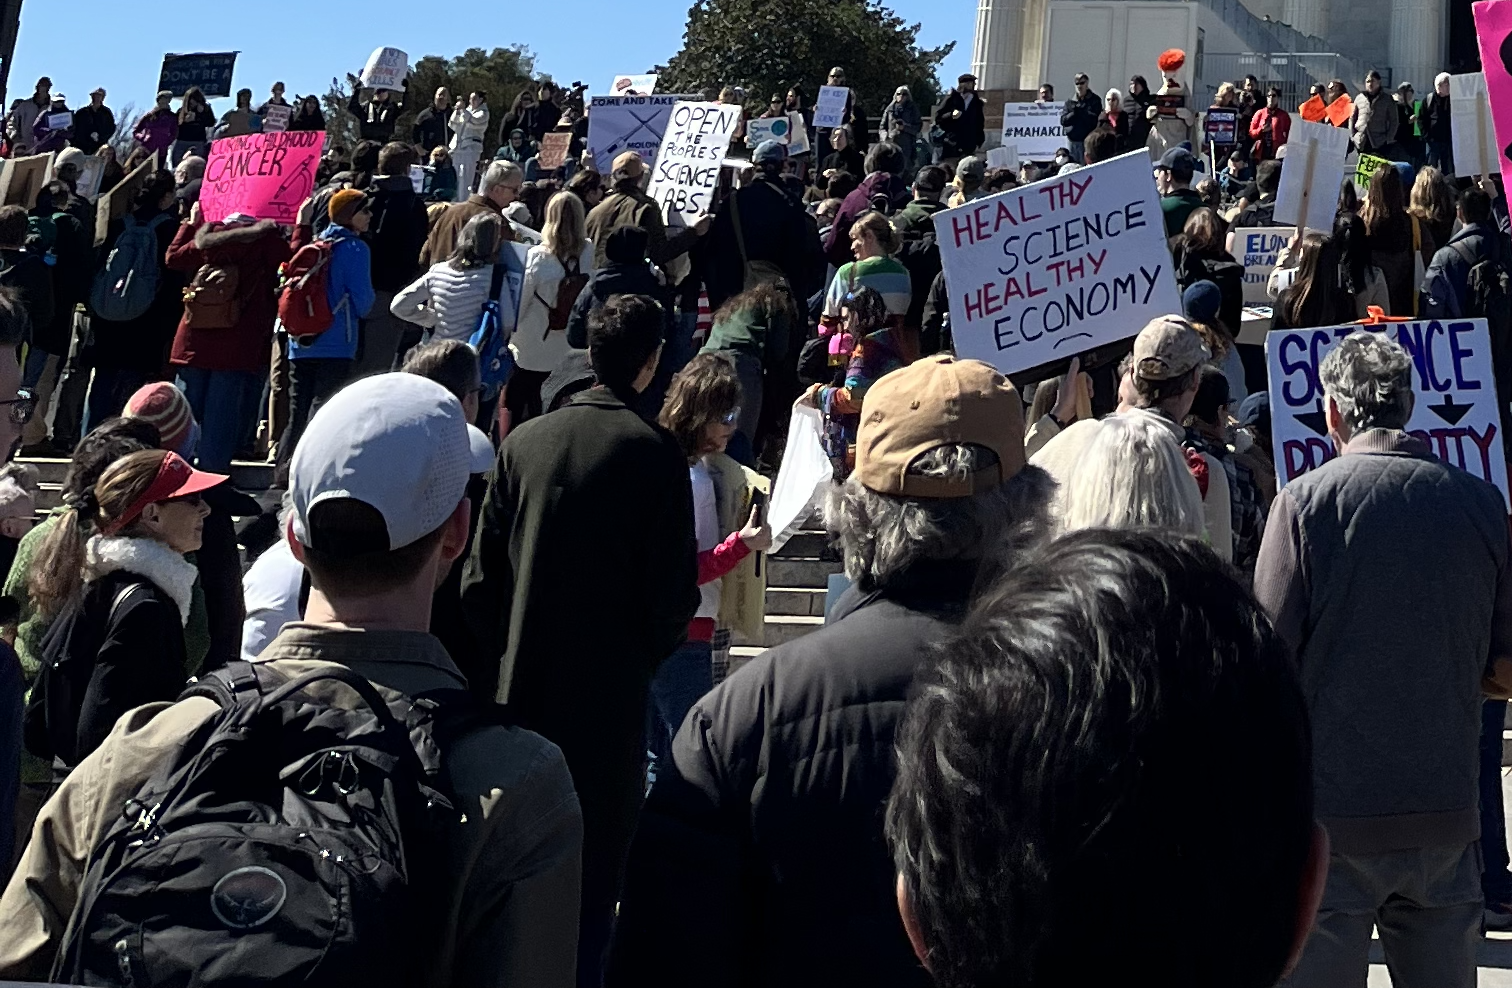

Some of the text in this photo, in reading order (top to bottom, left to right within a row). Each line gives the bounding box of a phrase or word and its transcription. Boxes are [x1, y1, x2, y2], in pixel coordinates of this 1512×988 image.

[591, 97, 674, 106] COME AND TAKE
[675, 106, 733, 134] OPEN
[255, 132, 319, 150] CHILDHOOD
[675, 131, 702, 144] THE
[207, 148, 287, 182] CANCER
[655, 160, 717, 187] SCIENCE
[213, 179, 236, 194] NOT
[952, 175, 1093, 248] HEALTHY
[998, 200, 1146, 275] SCIENCE
[1246, 234, 1288, 253] ELON
[963, 249, 1107, 322] HEALTHY
[994, 265, 1161, 351] ECONOMY
[1279, 321, 1481, 407] SCNCE
